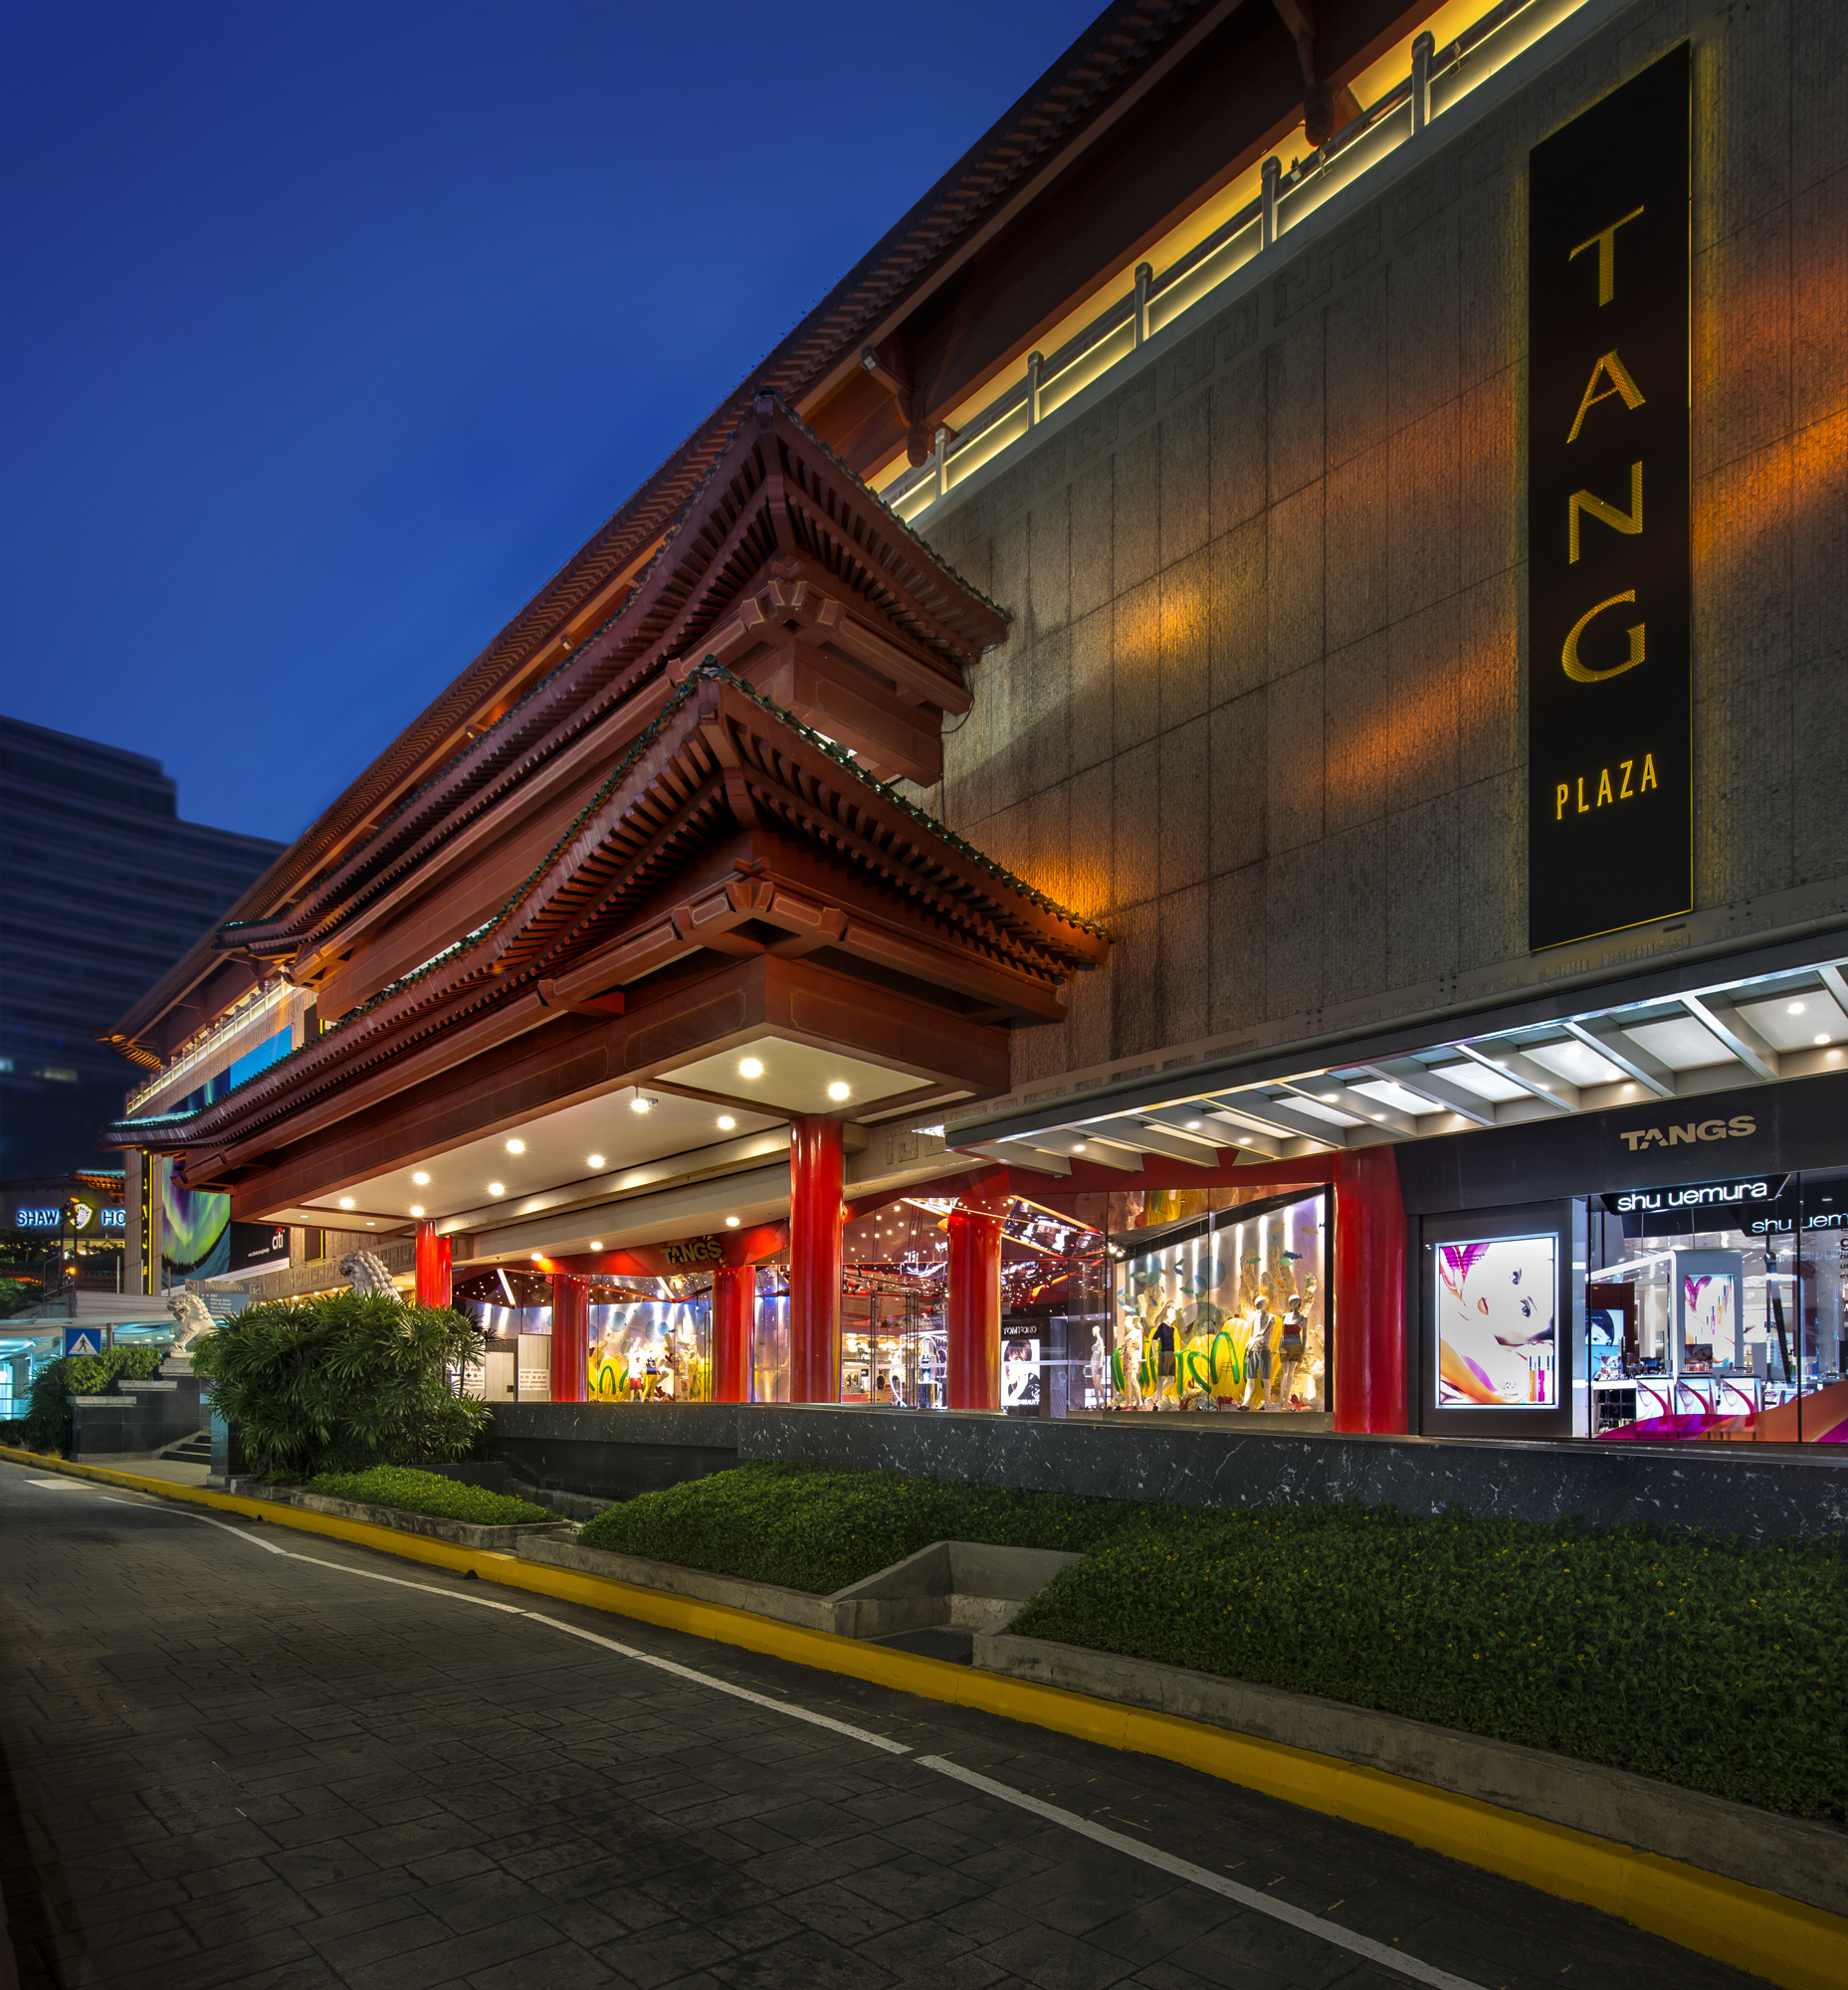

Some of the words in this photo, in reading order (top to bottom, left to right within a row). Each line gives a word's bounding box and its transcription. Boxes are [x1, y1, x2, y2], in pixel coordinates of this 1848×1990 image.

[1560, 204, 1646, 683] TANG
[1556, 753, 1658, 820] PLAZA
[1619, 1114, 1757, 1151] TANGS
[1617, 1193, 1661, 1212] shu
[1668, 1181, 1767, 1207] uemura
[16, 1209, 60, 1226] SHAW
[1751, 1218, 1792, 1233] shu
[660, 1240, 722, 1265] TANGS
[205, 1283, 244, 1292] UNDERPASS
